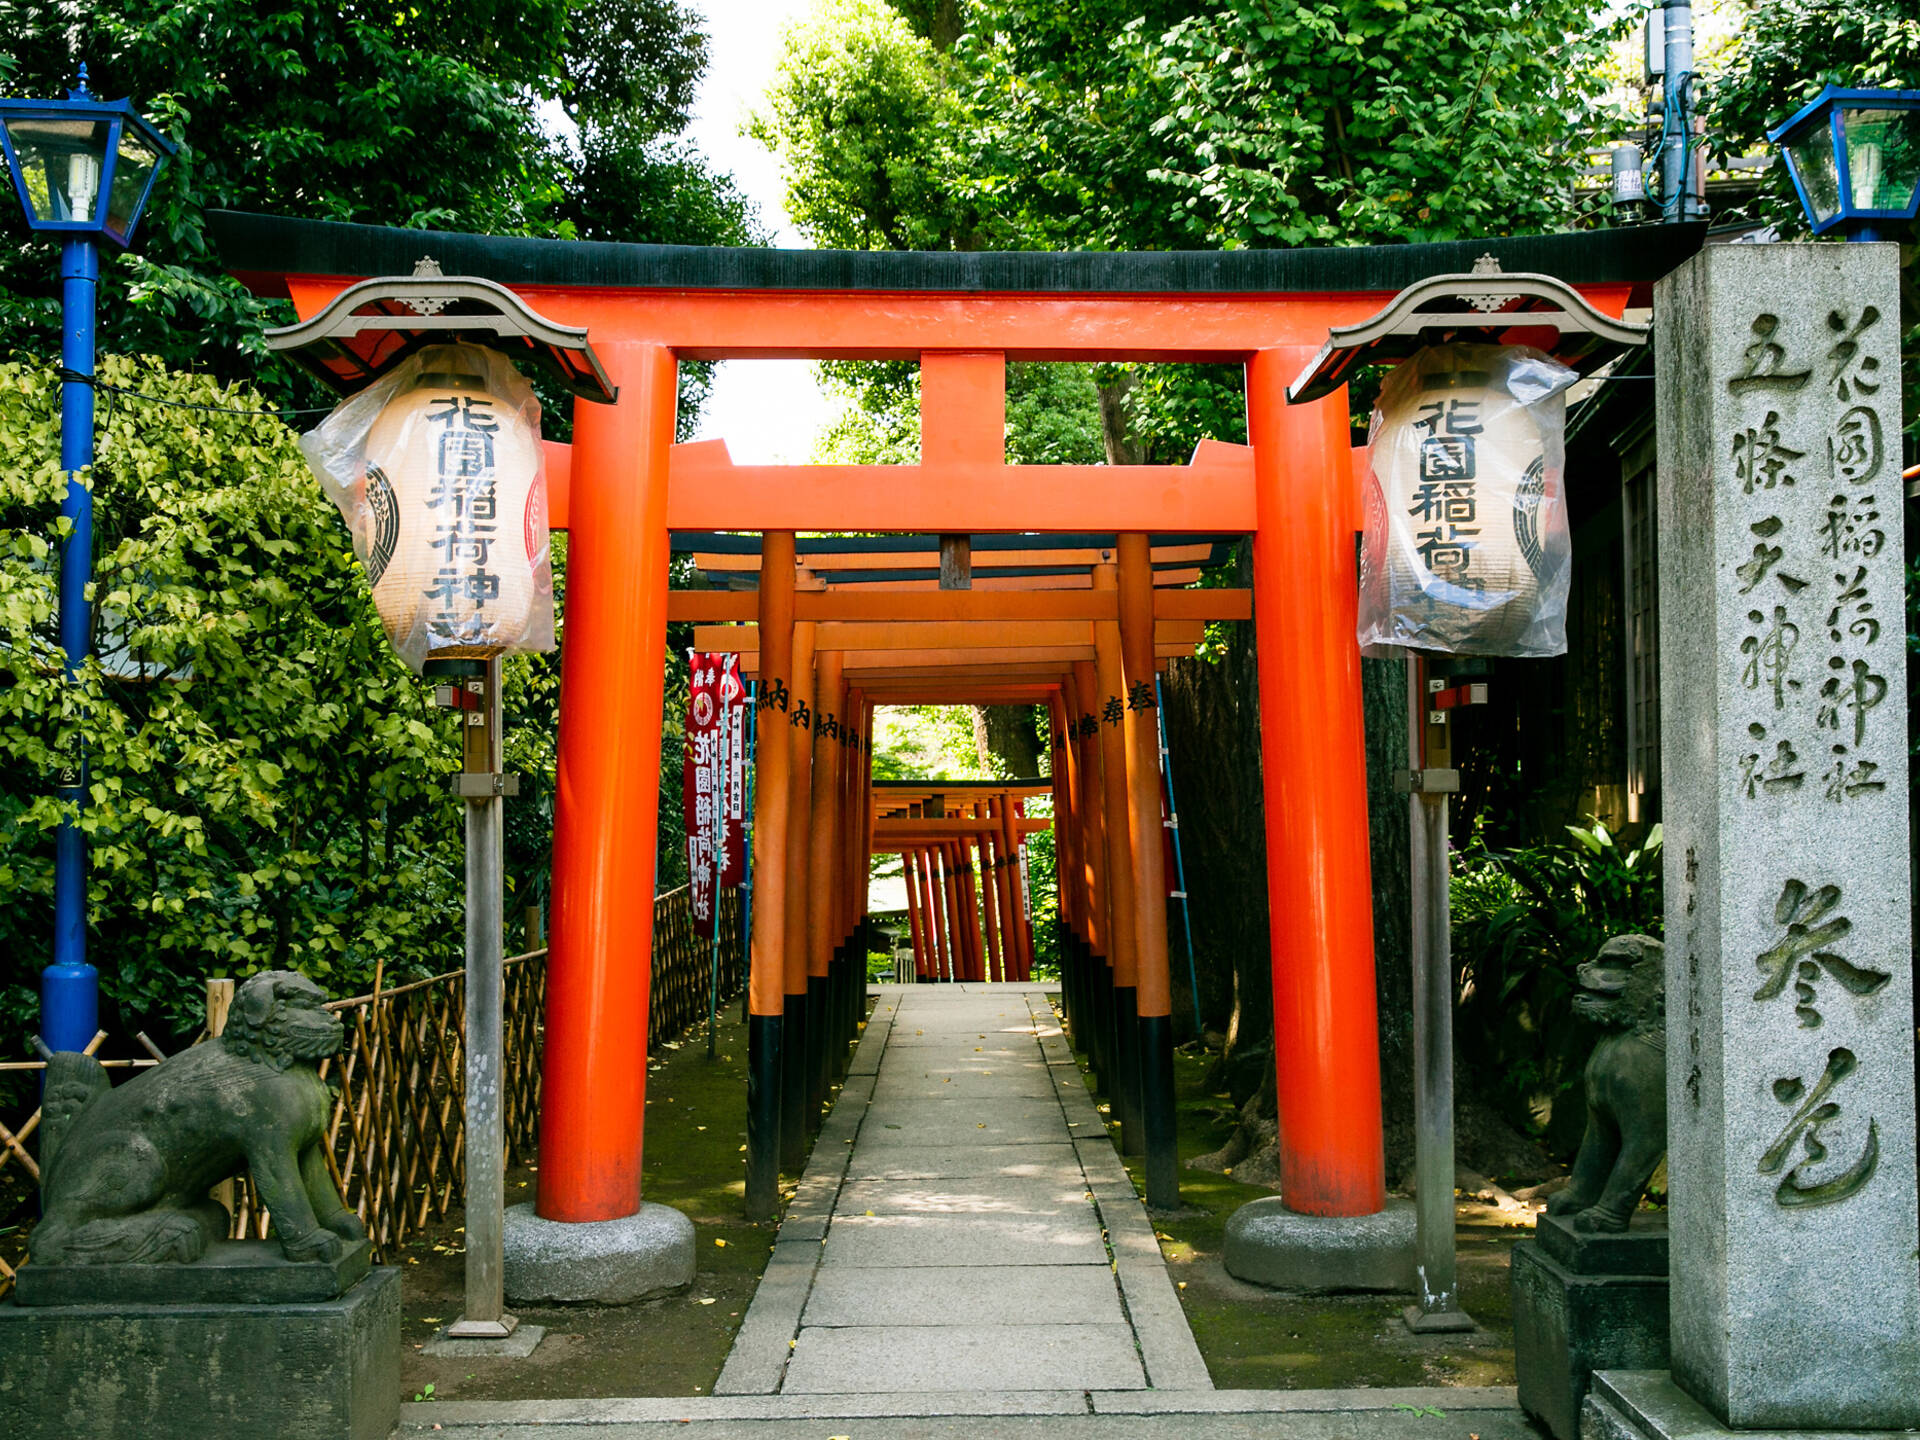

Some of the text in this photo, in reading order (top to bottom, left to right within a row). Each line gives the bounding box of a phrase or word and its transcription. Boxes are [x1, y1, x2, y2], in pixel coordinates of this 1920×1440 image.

[1408, 399, 1486, 638] 花園稲荷
[758, 678, 789, 713] 納
[1103, 696, 1124, 727] 奉
[1127, 680, 1156, 717] 奉
